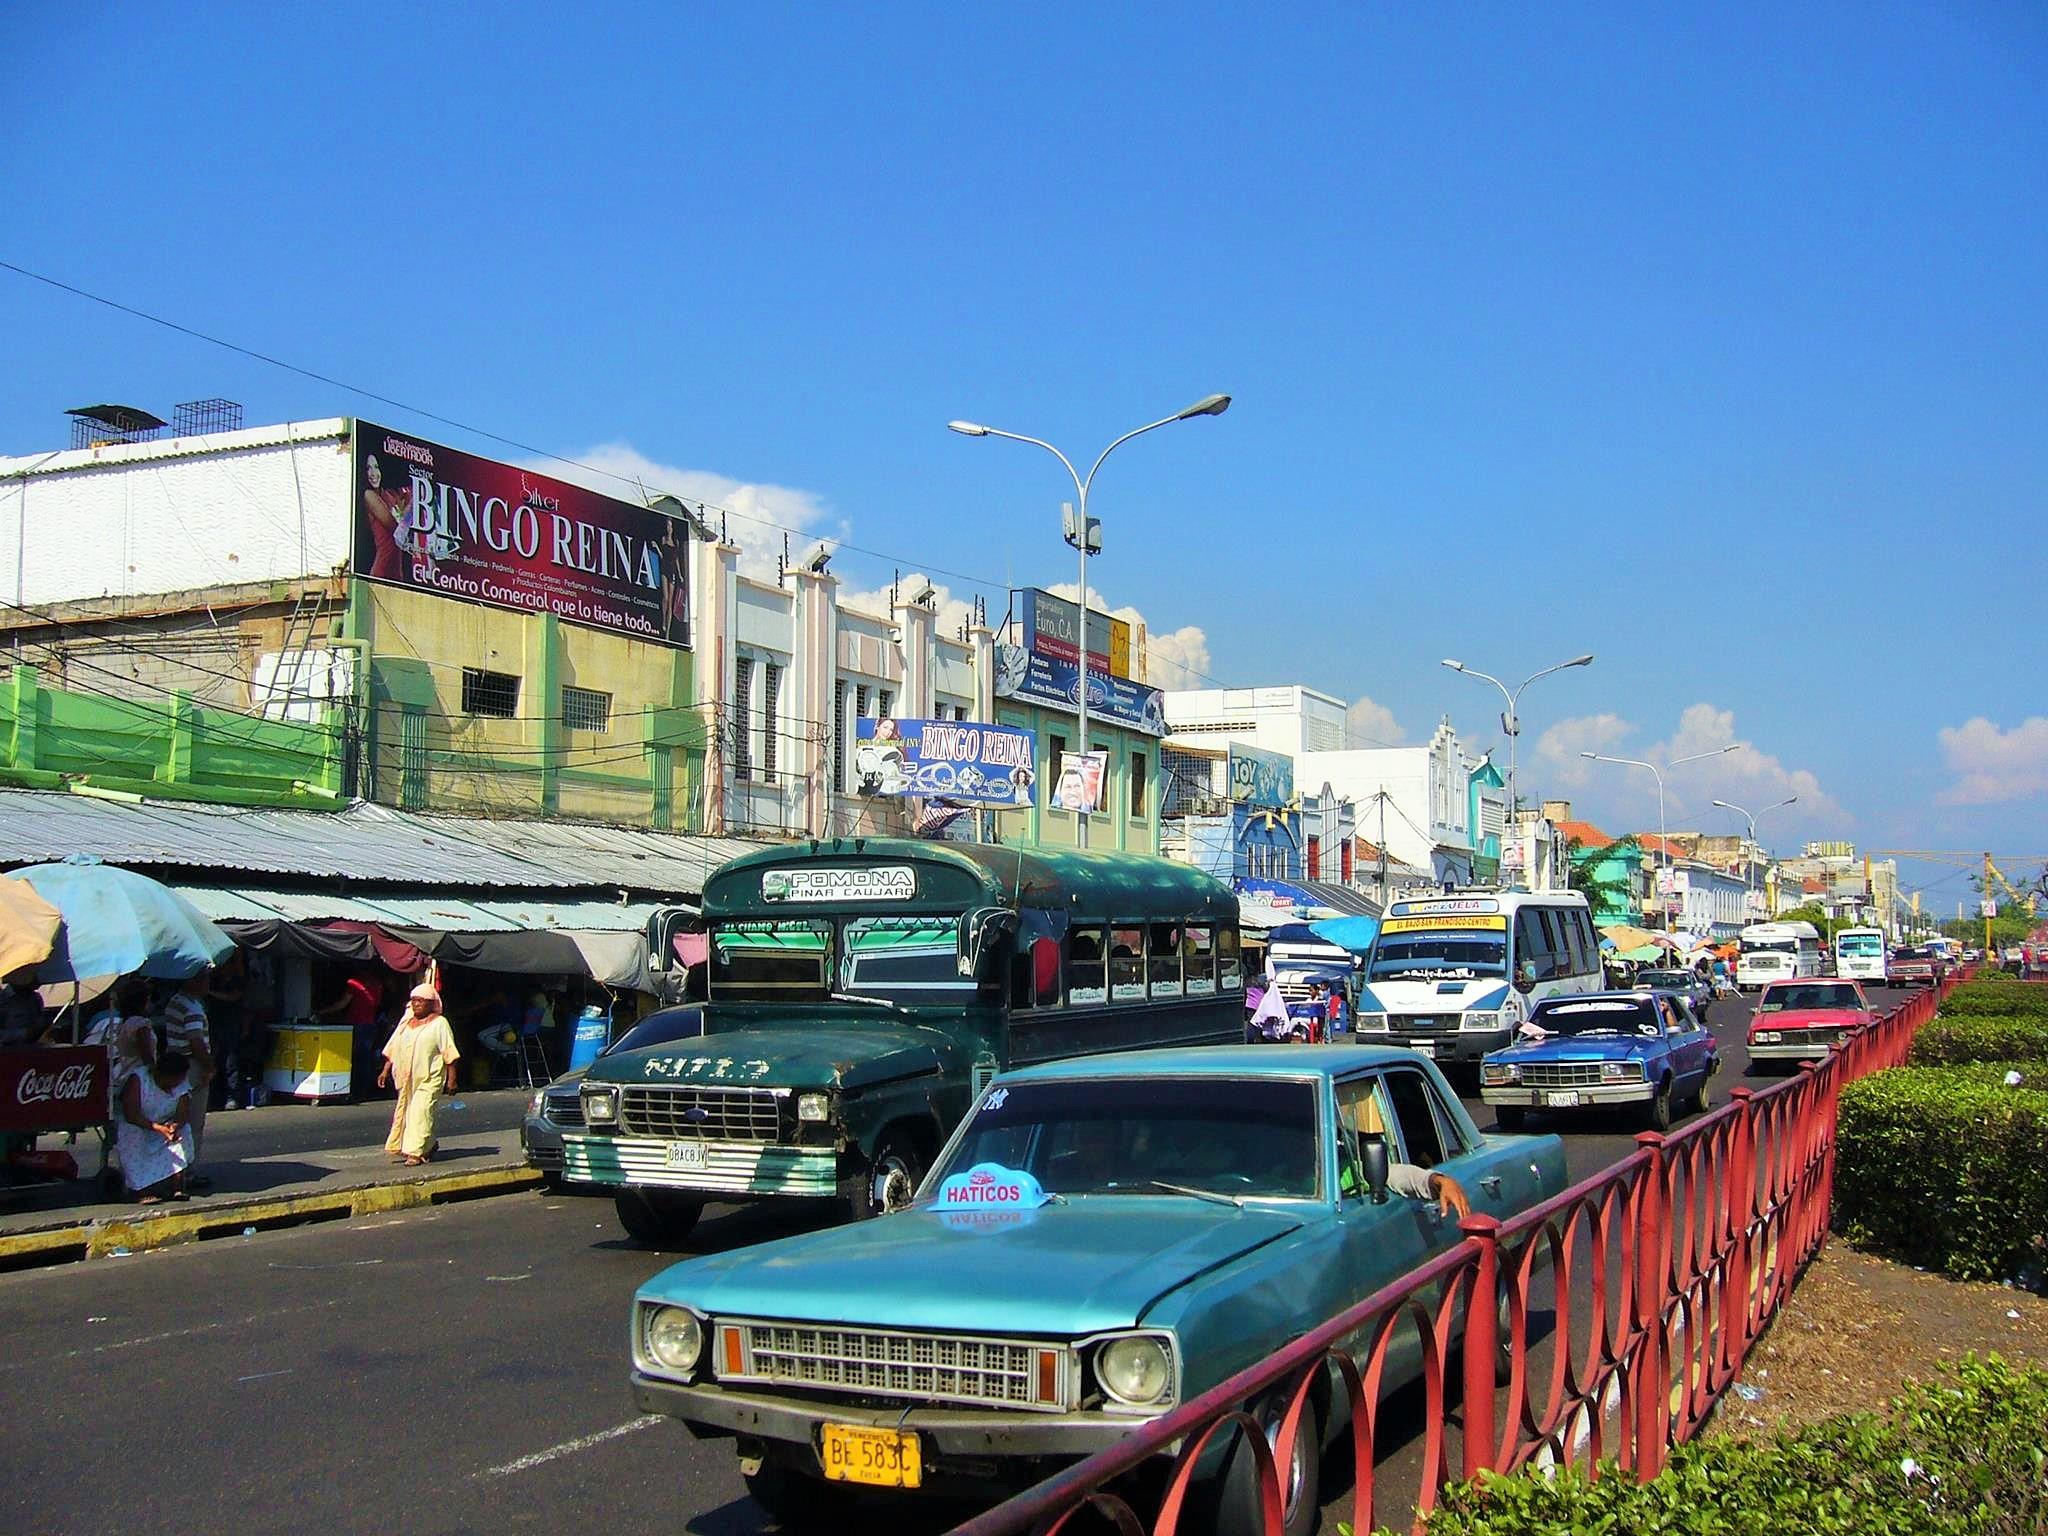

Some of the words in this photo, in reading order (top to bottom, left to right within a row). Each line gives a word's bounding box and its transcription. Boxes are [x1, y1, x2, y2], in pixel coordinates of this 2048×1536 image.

[408, 464, 434, 480] Sector
[520, 473, 560, 511] Silver
[409, 474, 540, 558] BINGO
[550, 513, 658, 590] REINA
[432, 567, 479, 594] Centro
[481, 578, 549, 610] Comercial
[552, 599, 576, 617] que
[578, 599, 592, 619] lo
[593, 604, 623, 626] tiene
[920, 726, 980, 763] BINGO
[980, 730, 1033, 769] REINA
[1231, 756, 1258, 786] TOY
[791, 871, 912, 888] POMONA
[791, 889, 834, 898] PINAR
[843, 887, 914, 897] CAUJARO
[947, 1185, 1020, 1203] HATICOS
[832, 1438, 855, 1466] BE
